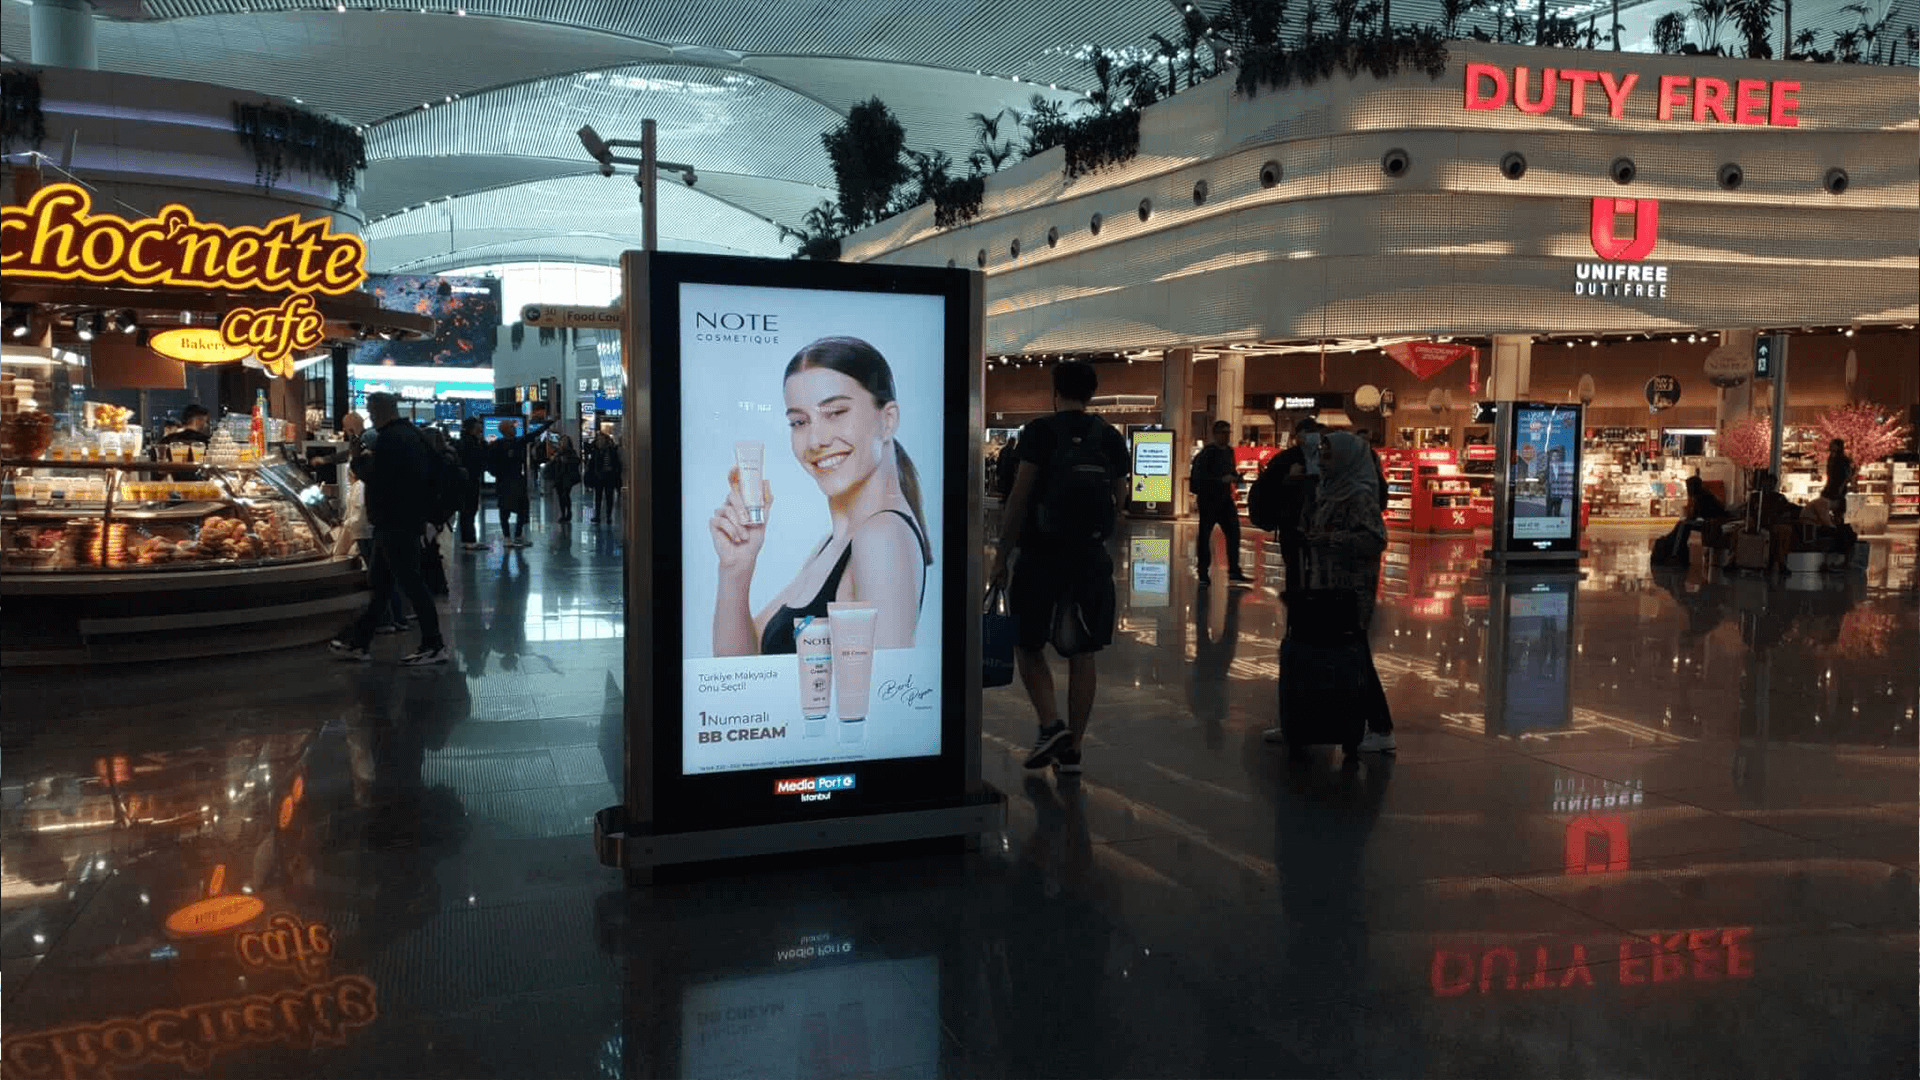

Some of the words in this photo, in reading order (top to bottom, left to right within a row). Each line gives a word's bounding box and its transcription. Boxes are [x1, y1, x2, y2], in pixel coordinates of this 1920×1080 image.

[1464, 62, 1640, 119] DUTY
[1657, 74, 1801, 127] FREE
[1575, 264, 1668, 282] UNIFREE
[567, 311, 595, 322] Food
[696, 312, 779, 331] NOTE
[696, 334, 779, 344] COSMETIQUE
[698, 673, 732, 683] Türkiye
[734, 670, 778, 681] Makyajda
[698, 684, 719, 693] Onu
[698, 731, 722, 744] BB
[778, 779, 815, 793] Media
[818, 777, 841, 789] Port
